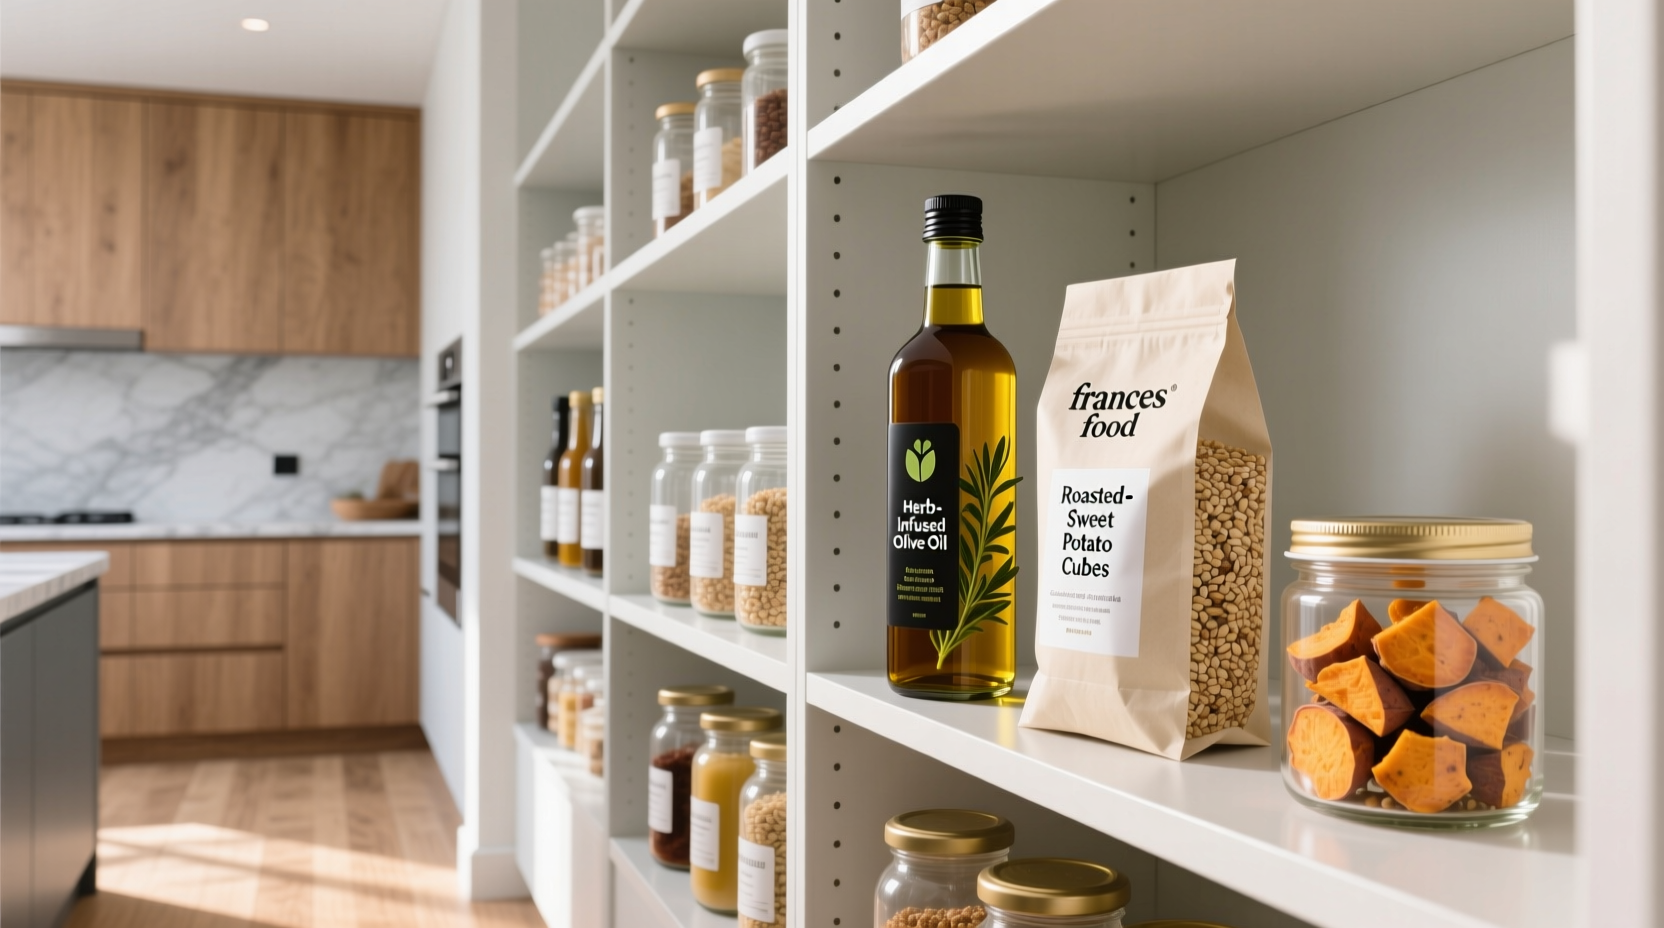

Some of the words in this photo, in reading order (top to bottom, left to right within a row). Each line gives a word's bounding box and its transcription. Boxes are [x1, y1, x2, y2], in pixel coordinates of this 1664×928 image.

[1079, 412, 1141, 438] food
[1061, 485, 1133, 504] Roasted-
[903, 498, 942, 514] Herb-
[897, 516, 946, 532] Infused
[1067, 508, 1115, 528] Sweet
[1063, 532, 1113, 552] Potato
[1062, 556, 1110, 577] Cubes
